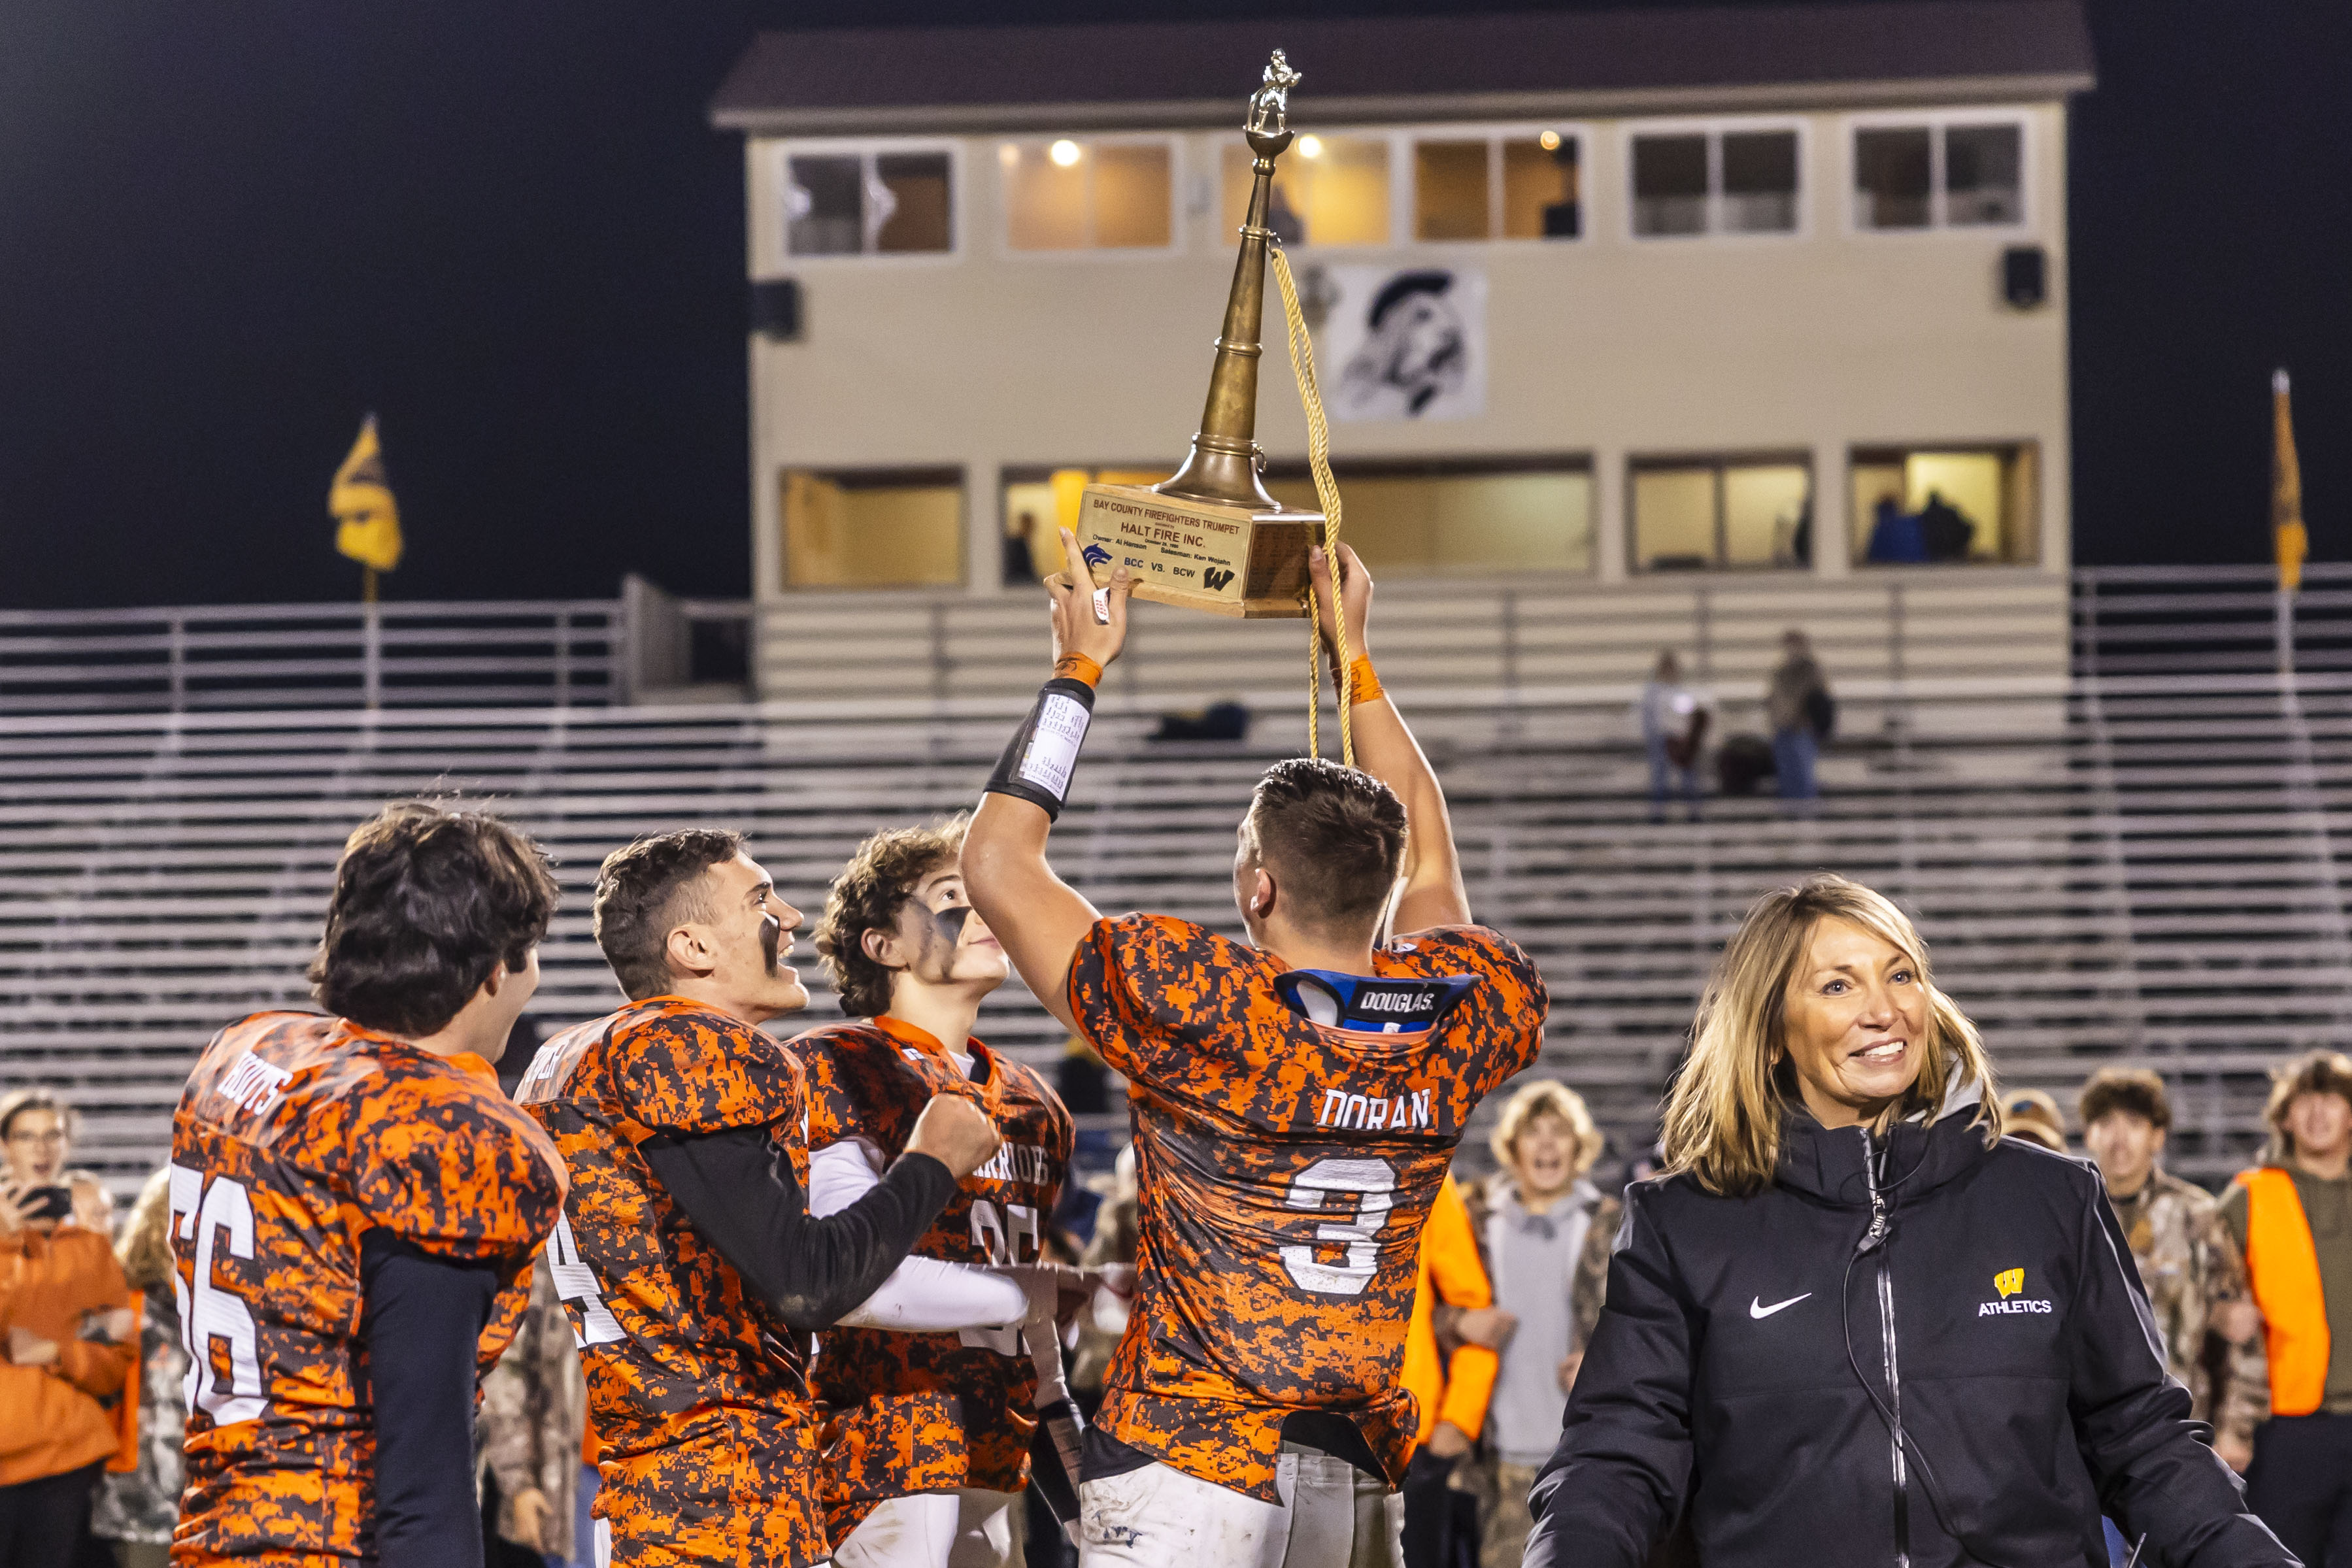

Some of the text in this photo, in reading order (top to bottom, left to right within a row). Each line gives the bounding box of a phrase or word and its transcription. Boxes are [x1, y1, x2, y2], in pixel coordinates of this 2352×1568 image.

[1094, 499, 1109, 510] BAY
[1111, 503, 1143, 516] COUNTY
[1144, 509, 1200, 527] FIREFIGHTERS
[1202, 520, 1240, 535] TRUMPET
[1120, 522, 1152, 537] HALT
[1154, 528, 1181, 542] FIRE
[1183, 533, 1206, 548] INC.
[1124, 557, 1196, 578] BCC VS. BCW
[1160, 546, 1192, 559] Salesman:
[1317, 1088, 1431, 1131] DORAN
[1279, 1158, 1396, 1295] 3
[166, 1163, 269, 1426] 56
[1993, 1267, 2025, 1300] W
[1978, 1299, 2053, 1317] ATHLETICS
